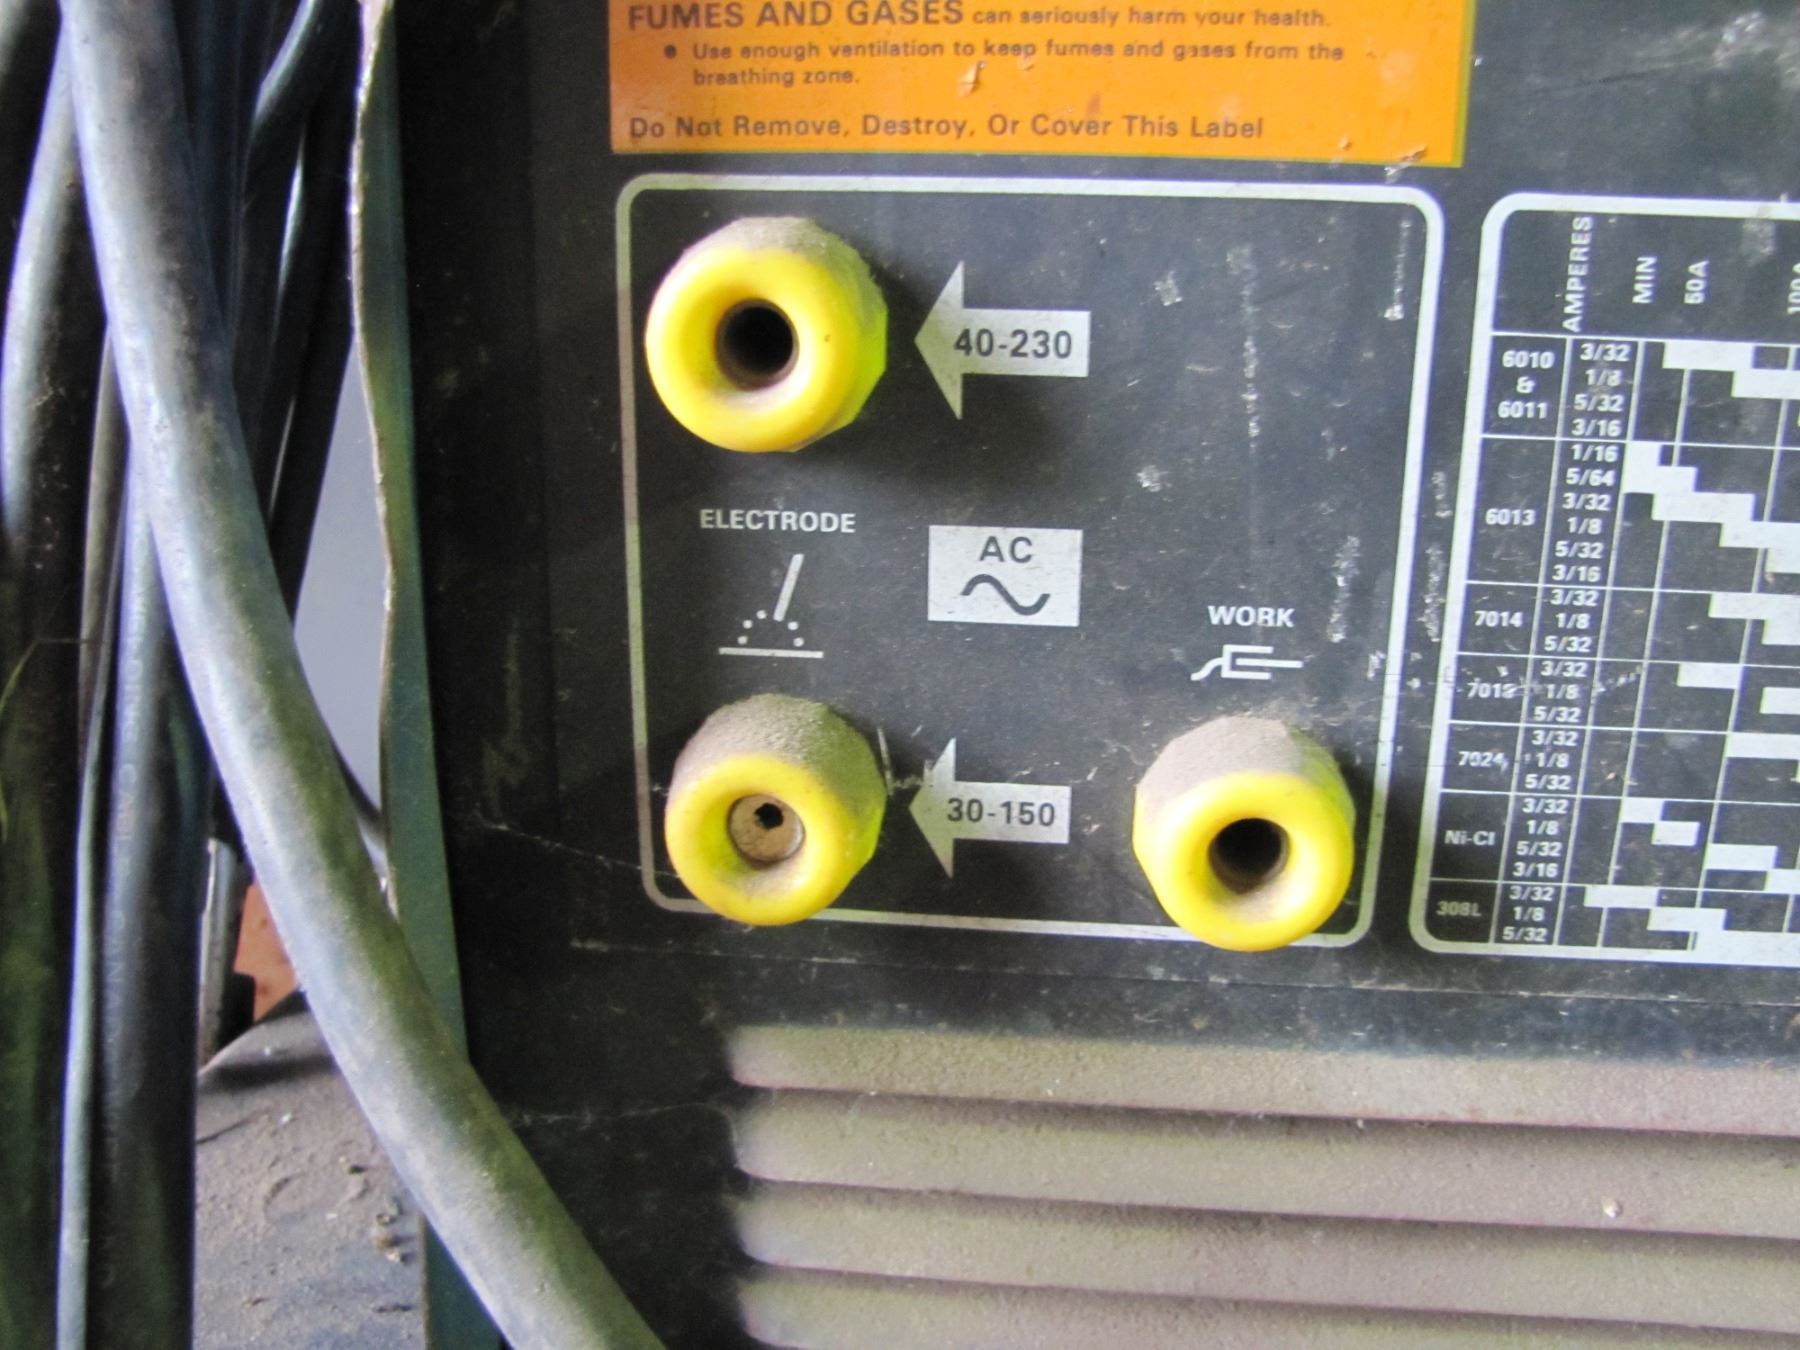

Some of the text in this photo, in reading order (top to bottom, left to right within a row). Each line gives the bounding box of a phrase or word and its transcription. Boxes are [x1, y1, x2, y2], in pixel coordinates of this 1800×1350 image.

[628, 0, 1331, 30] FUMES AND GASES can seriously harm your health.
[693, 44, 731, 60] Use
[740, 44, 820, 62] enough
[829, 41, 944, 57] ventilation
[953, 41, 975, 57] to
[984, 40, 1036, 58] keep
[1046, 40, 1114, 57] fumes
[1124, 40, 1164, 57] and
[1245, 41, 1298, 59] from
[1308, 43, 1344, 61] the
[693, 69, 859, 87] breathing zone.
[629, 114, 1263, 138] Do Not Remove, Destroy, Or Cover This Label
[1562, 216, 1594, 332] AMPERES
[1632, 256, 1657, 304] MIN
[1684, 260, 1709, 304] 50A
[955, 328, 1073, 358] 40-230
[1502, 351, 1555, 368] 6010
[1579, 343, 1631, 362] 3/32
[1516, 376, 1535, 393] &
[1585, 369, 1622, 386] 1/8
[1498, 401, 1548, 419] 6011
[1573, 394, 1625, 412] 5/32
[1571, 419, 1622, 437] 3/16
[1571, 444, 1619, 462] 1/16
[1565, 467, 1616, 487] 5/64
[1561, 492, 1612, 511] 3/32
[700, 509, 856, 533] ELECTRODE
[1485, 508, 1537, 526] 6013
[1567, 517, 1603, 535] 1/8
[978, 535, 1034, 564] AC
[1554, 541, 1604, 559] 5/32
[1551, 565, 1601, 582] 3/16
[1550, 589, 1600, 607] 3/32
[1208, 605, 1295, 628] WORK
[1474, 610, 1524, 628] 7014
[1555, 613, 1591, 629] 1/8
[1544, 635, 1592, 653] 5/32
[1540, 661, 1588, 678] 3/32
[1545, 684, 1581, 700] 1/8
[1533, 706, 1582, 723] 5/32
[1531, 730, 1579, 747] 3/32
[1458, 752, 1508, 768] 7024
[1537, 752, 1569, 768] 1/8
[1525, 774, 1571, 791] 5/32
[946, 798, 1056, 827] 30-150
[1522, 797, 1567, 814] 3/32
[1527, 820, 1559, 835] 1/8
[1516, 842, 1562, 857] 5/32
[1513, 862, 1558, 877] 3/16
[1510, 886, 1555, 900] 3/32
[1437, 902, 1482, 917] 308L
[1514, 906, 1545, 920] 1/8
[1503, 926, 1547, 942] 5/32
